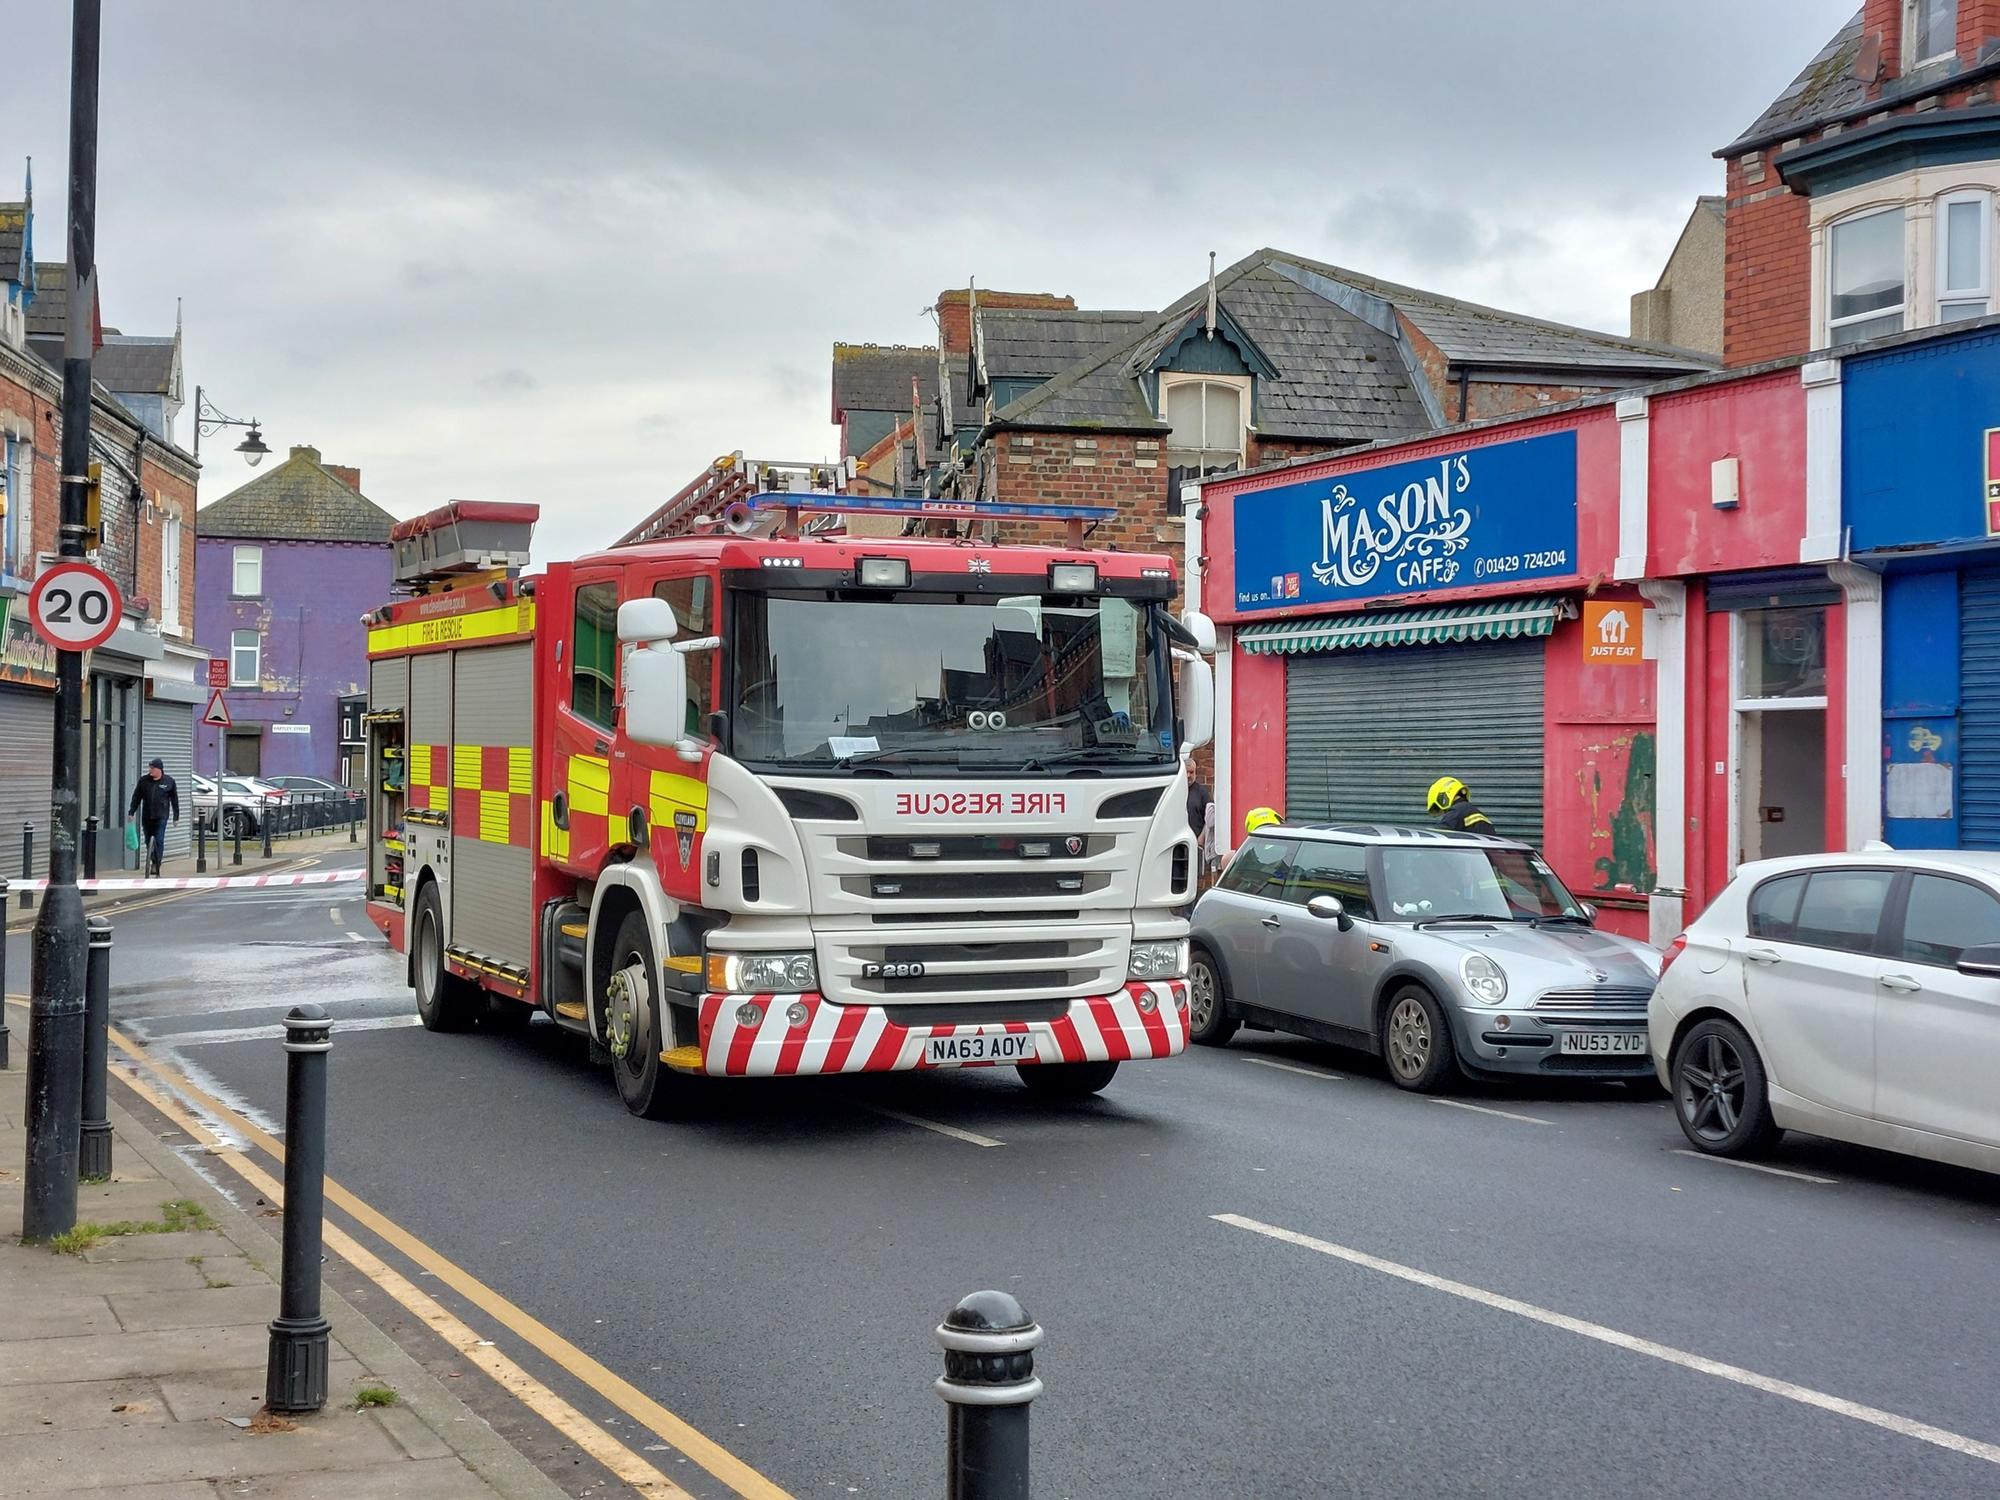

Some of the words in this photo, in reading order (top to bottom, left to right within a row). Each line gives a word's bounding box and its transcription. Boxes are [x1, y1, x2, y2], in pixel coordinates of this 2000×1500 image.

[1486, 556, 1519, 574] 01429
[1523, 550, 1566, 570] 724204
[1251, 593, 1258, 601] us
[45, 588, 108, 625] 20
[423, 623, 435, 642] FIRE
[440, 618, 463, 640] RESCUE
[1590, 646, 1616, 657] JUST
[1615, 646, 1636, 657] EAT
[866, 965, 880, 977] P
[882, 963, 923, 977] 280
[933, 1039, 984, 1060] NA63
[1568, 1034, 1609, 1050] NU53
[1613, 1035, 1640, 1050] ZVD
